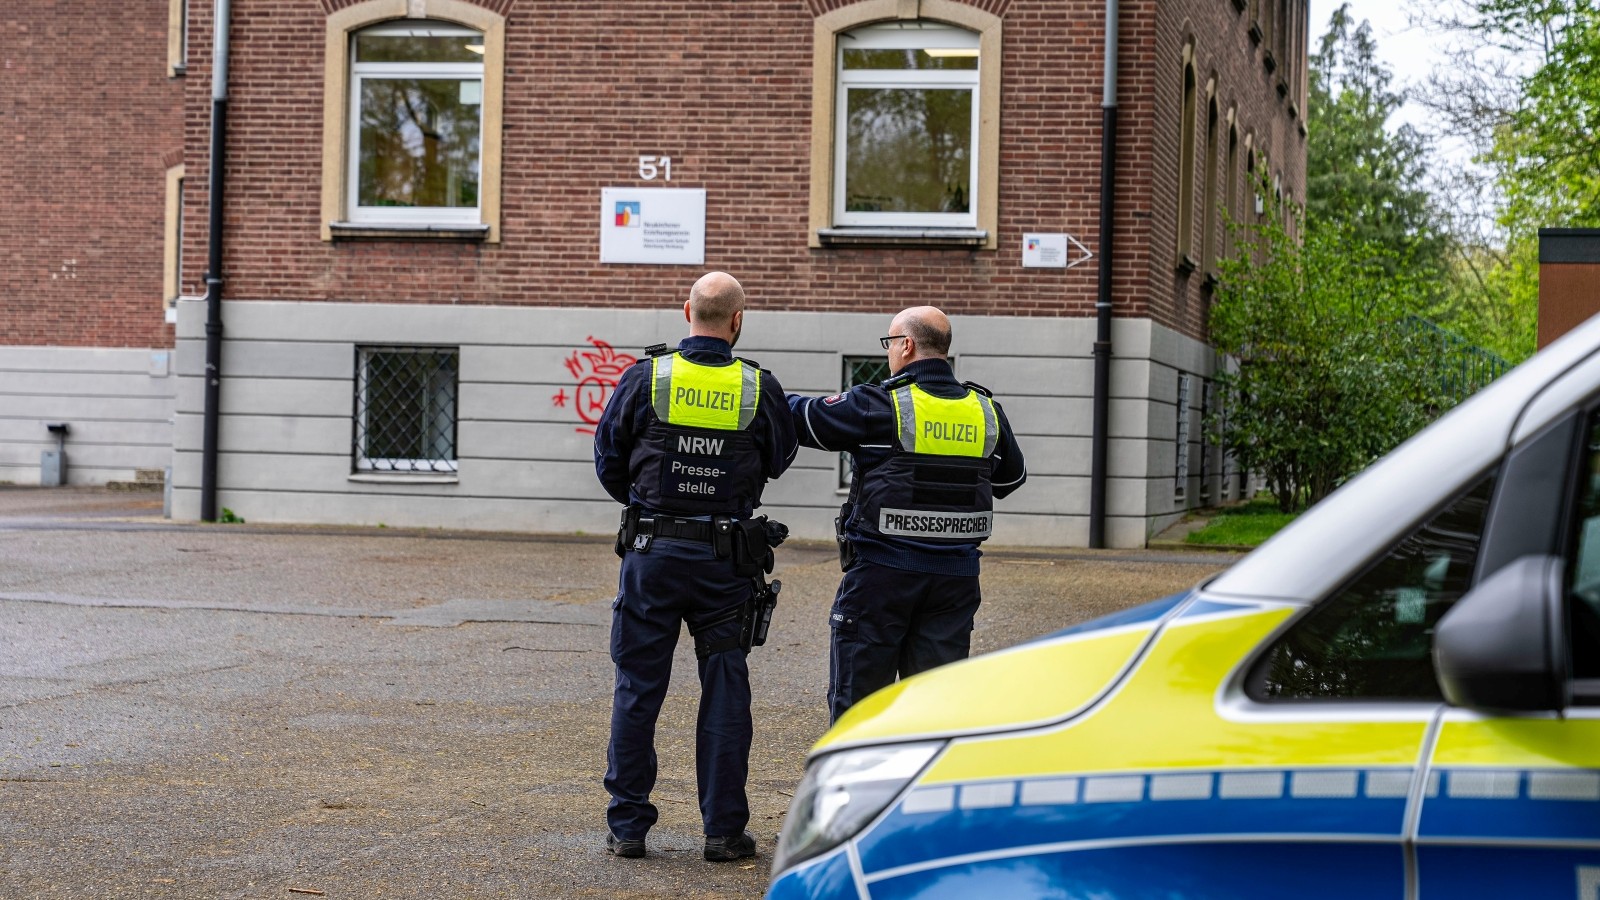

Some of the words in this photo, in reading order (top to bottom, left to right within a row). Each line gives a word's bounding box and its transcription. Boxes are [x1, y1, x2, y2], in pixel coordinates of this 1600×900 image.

[638, 154, 672, 181] 51
[675, 386, 735, 411] POLIZEI
[923, 420, 978, 443] POLIZEI
[677, 435, 725, 456] NRW
[671, 460, 727, 478] Presse-
[677, 481, 716, 495] stelle
[884, 513, 988, 534] PRESSESPRECHER
